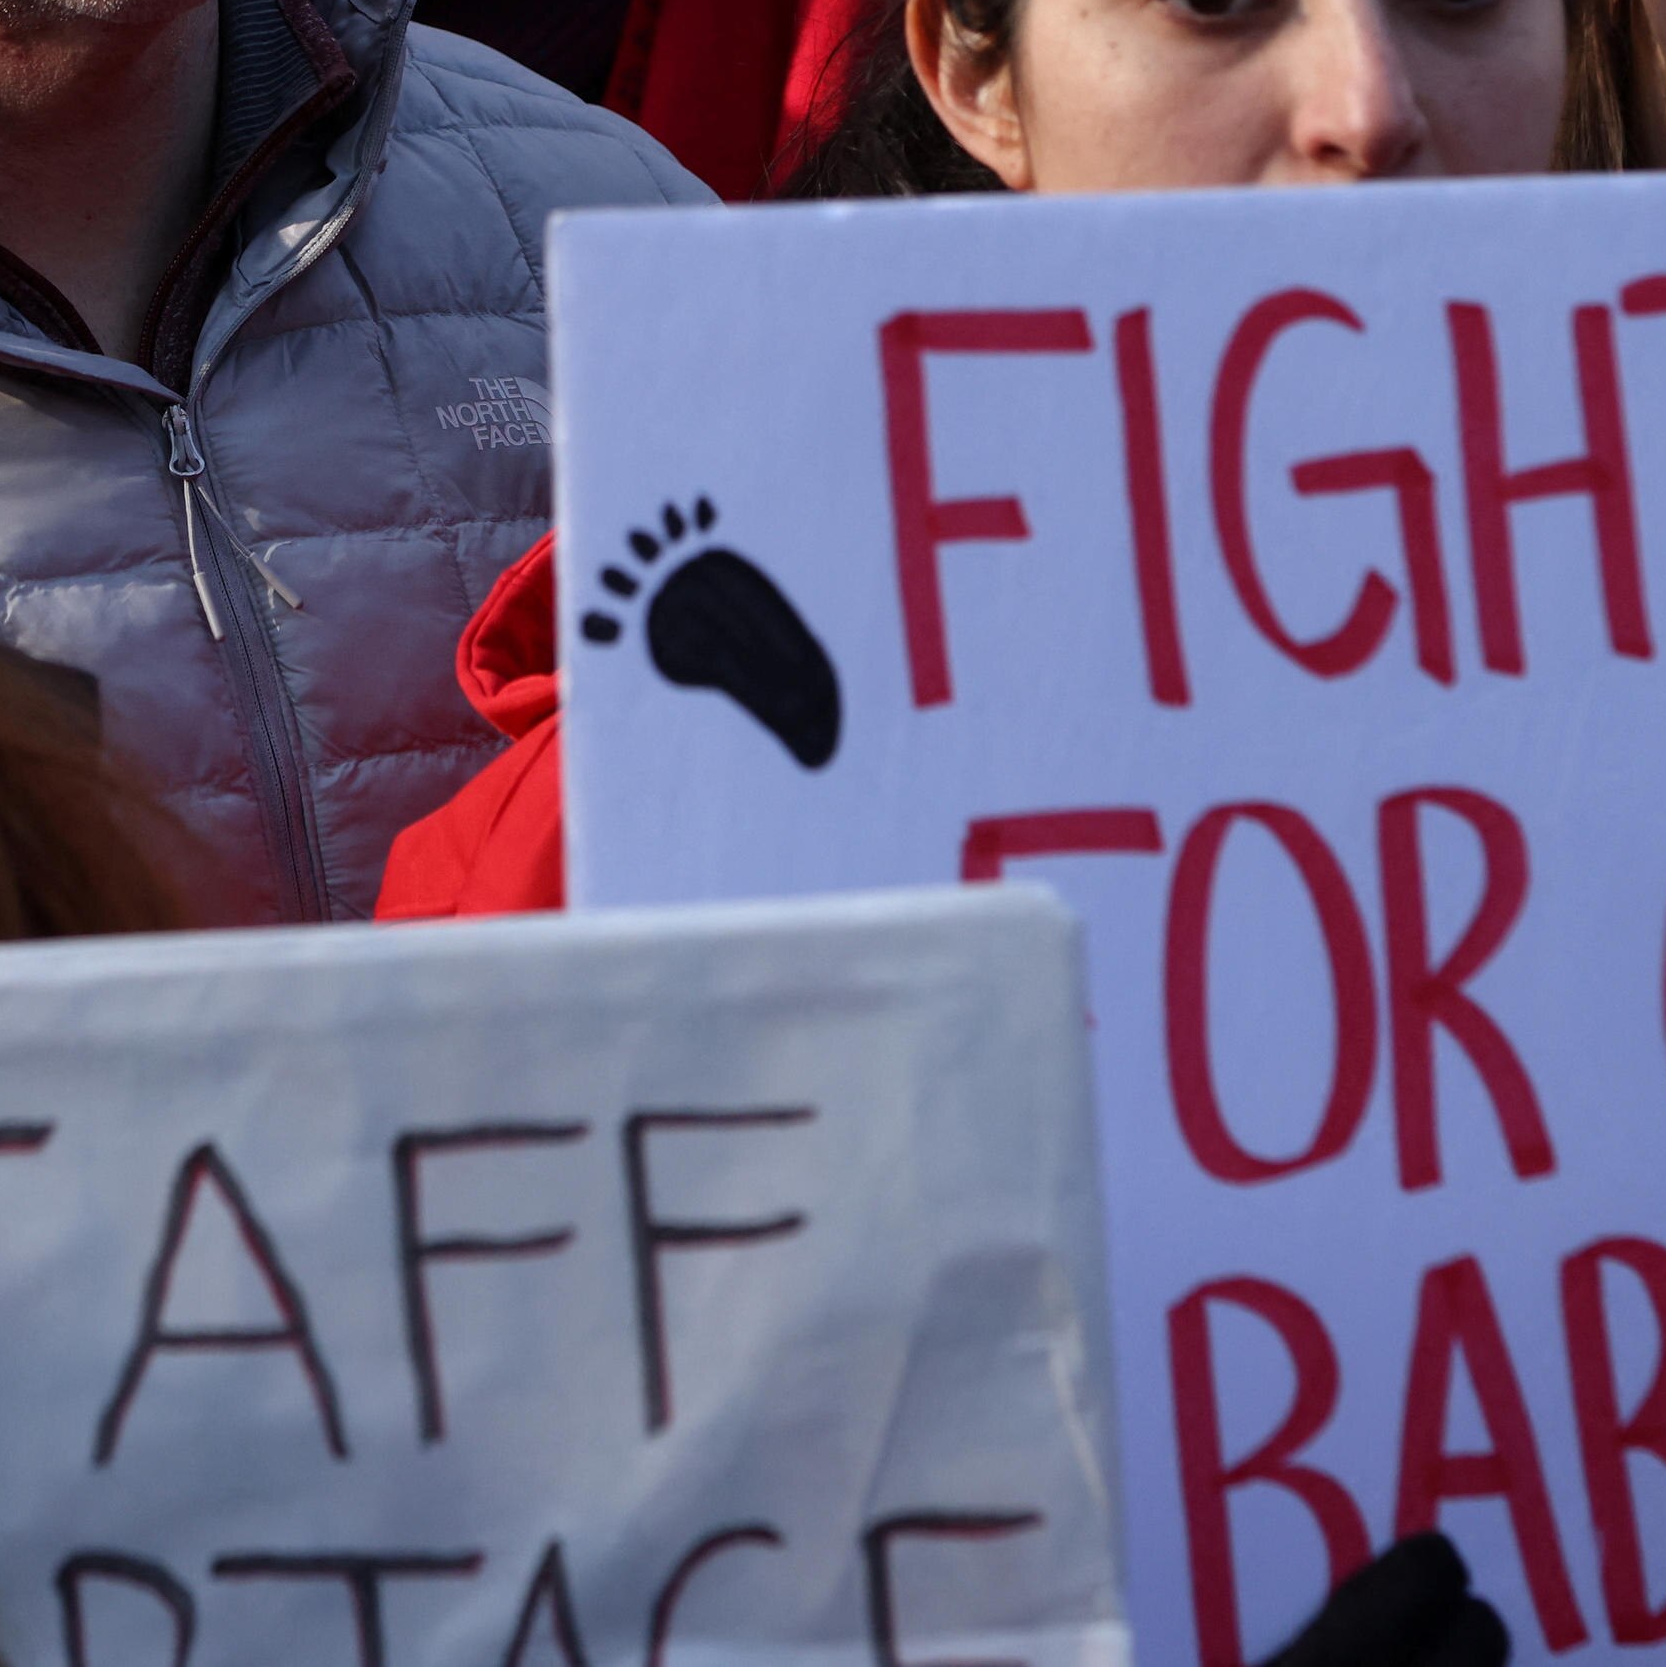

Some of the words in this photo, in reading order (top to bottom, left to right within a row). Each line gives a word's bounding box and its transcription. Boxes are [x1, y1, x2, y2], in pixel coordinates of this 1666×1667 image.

[468, 376, 522, 400] THE
[435, 397, 532, 430] NORTH
[471, 421, 541, 451] FACE
